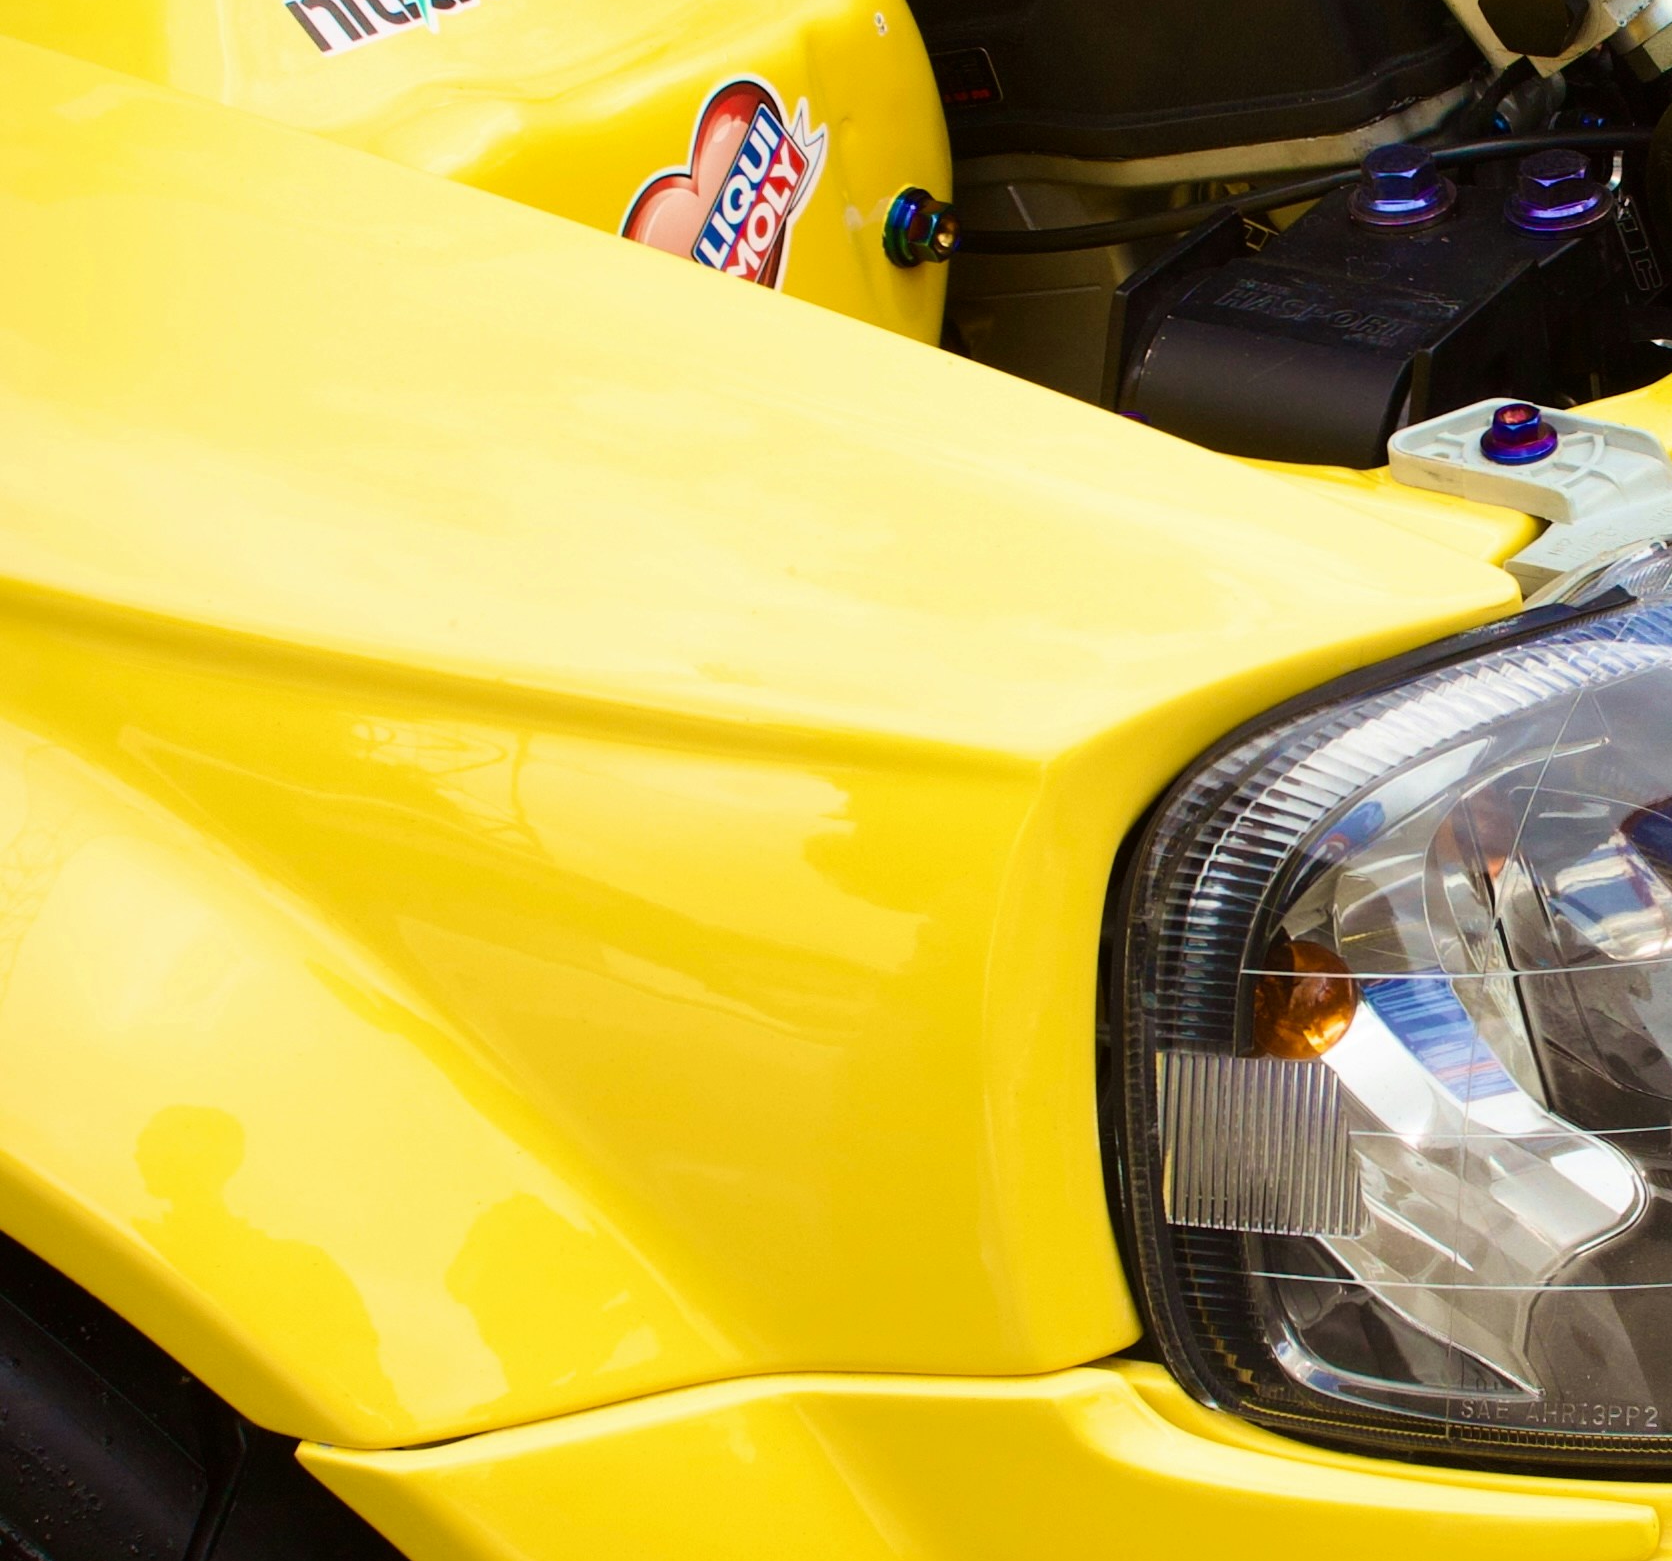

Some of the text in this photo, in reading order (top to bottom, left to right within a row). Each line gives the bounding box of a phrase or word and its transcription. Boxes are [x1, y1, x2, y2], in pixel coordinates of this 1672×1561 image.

[698, 115, 781, 270] LIQUI
[726, 140, 799, 277] MOLY
[1460, 1398, 1509, 1421] SAE
